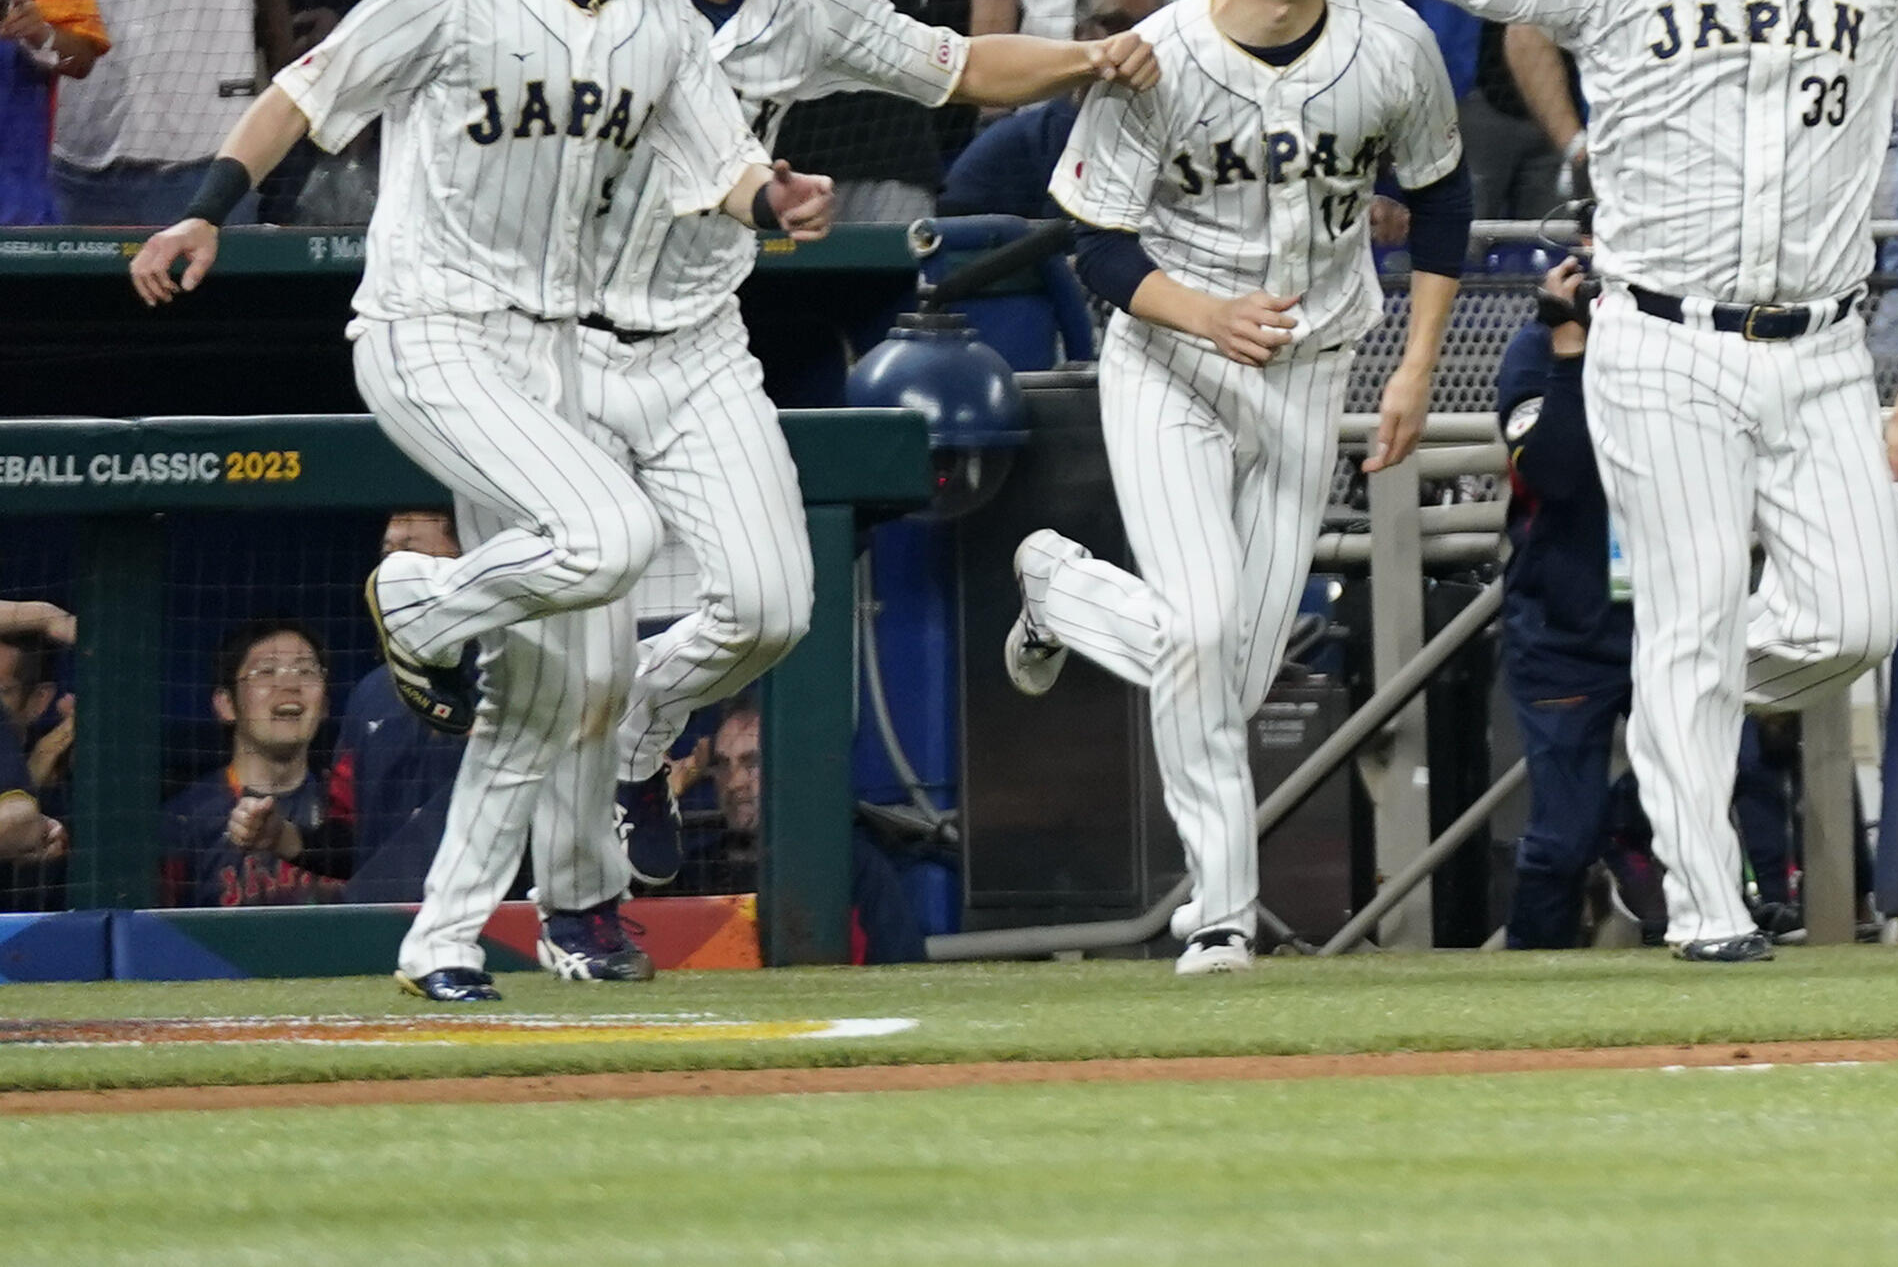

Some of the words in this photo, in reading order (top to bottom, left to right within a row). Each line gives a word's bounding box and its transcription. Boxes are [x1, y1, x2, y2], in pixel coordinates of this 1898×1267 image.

[1801, 74, 1849, 128] 33
[0, 455, 84, 484] BALL
[88, 452, 221, 483] CLASSIC
[225, 451, 302, 481] 2023
